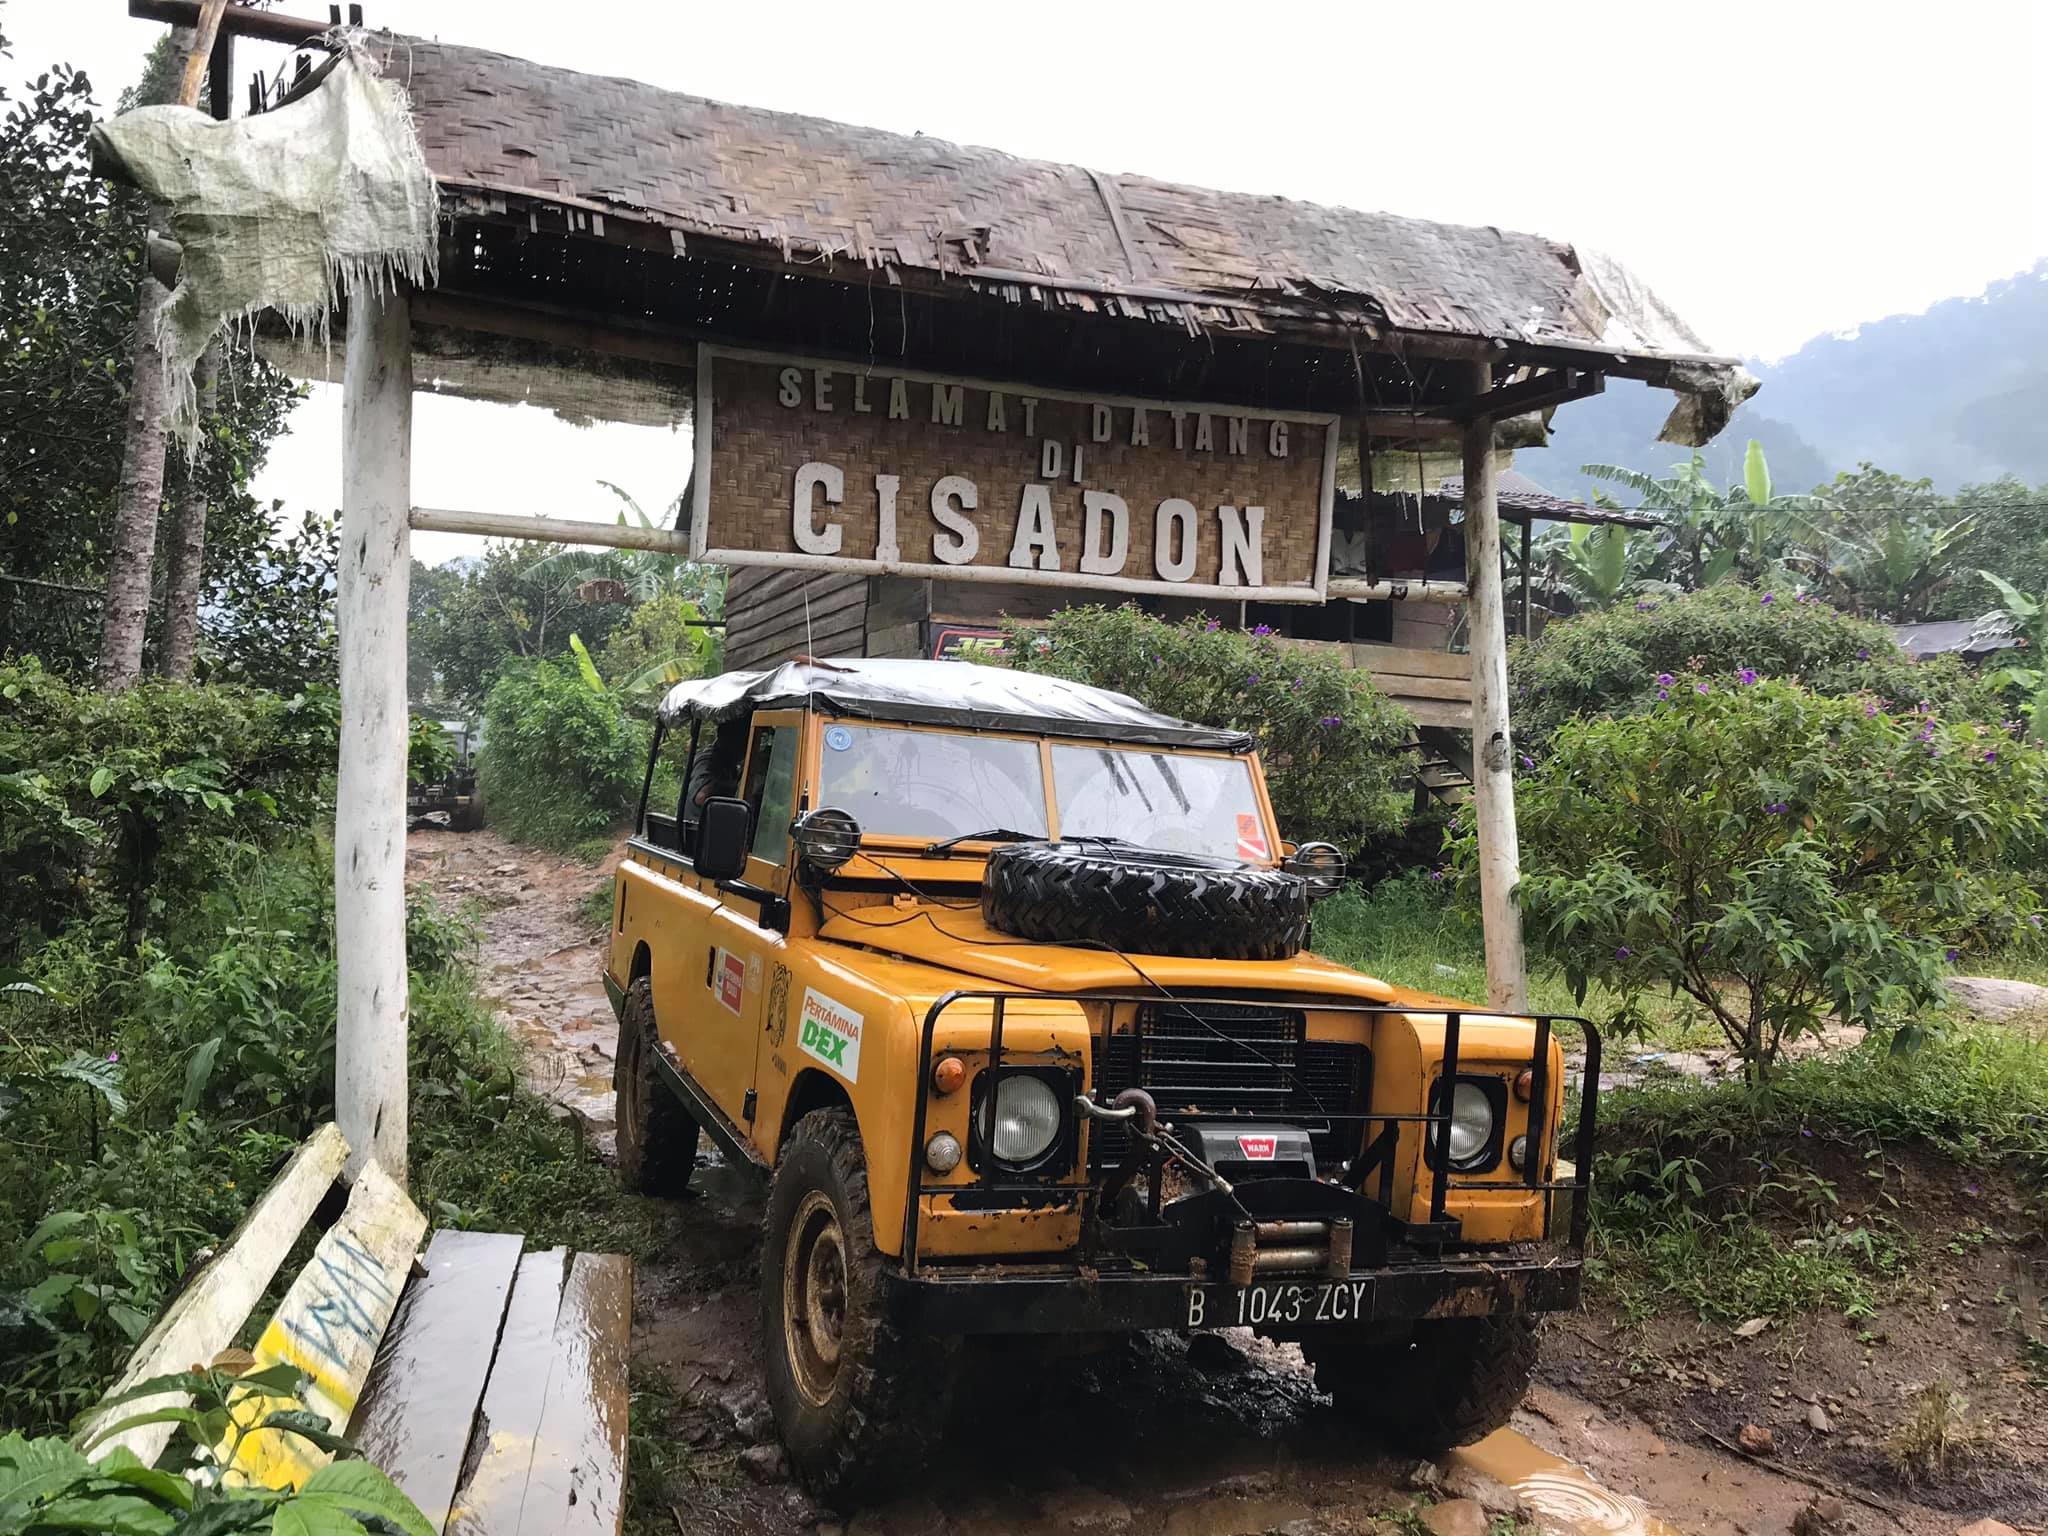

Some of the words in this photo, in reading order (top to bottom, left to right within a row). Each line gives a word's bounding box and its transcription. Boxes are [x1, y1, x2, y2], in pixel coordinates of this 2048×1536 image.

[779, 368, 1038, 436] SELAMAT
[1092, 403, 1288, 458] DATANG
[1042, 439, 1083, 483] DI
[793, 462, 1265, 587] CISADON
[804, 994, 859, 1041] PERTAMINA
[802, 1019, 848, 1067] DEX
[1188, 1289, 1206, 1327] B
[1237, 1286, 1301, 1325] 1043
[1315, 1282, 1366, 1322] ZCY
